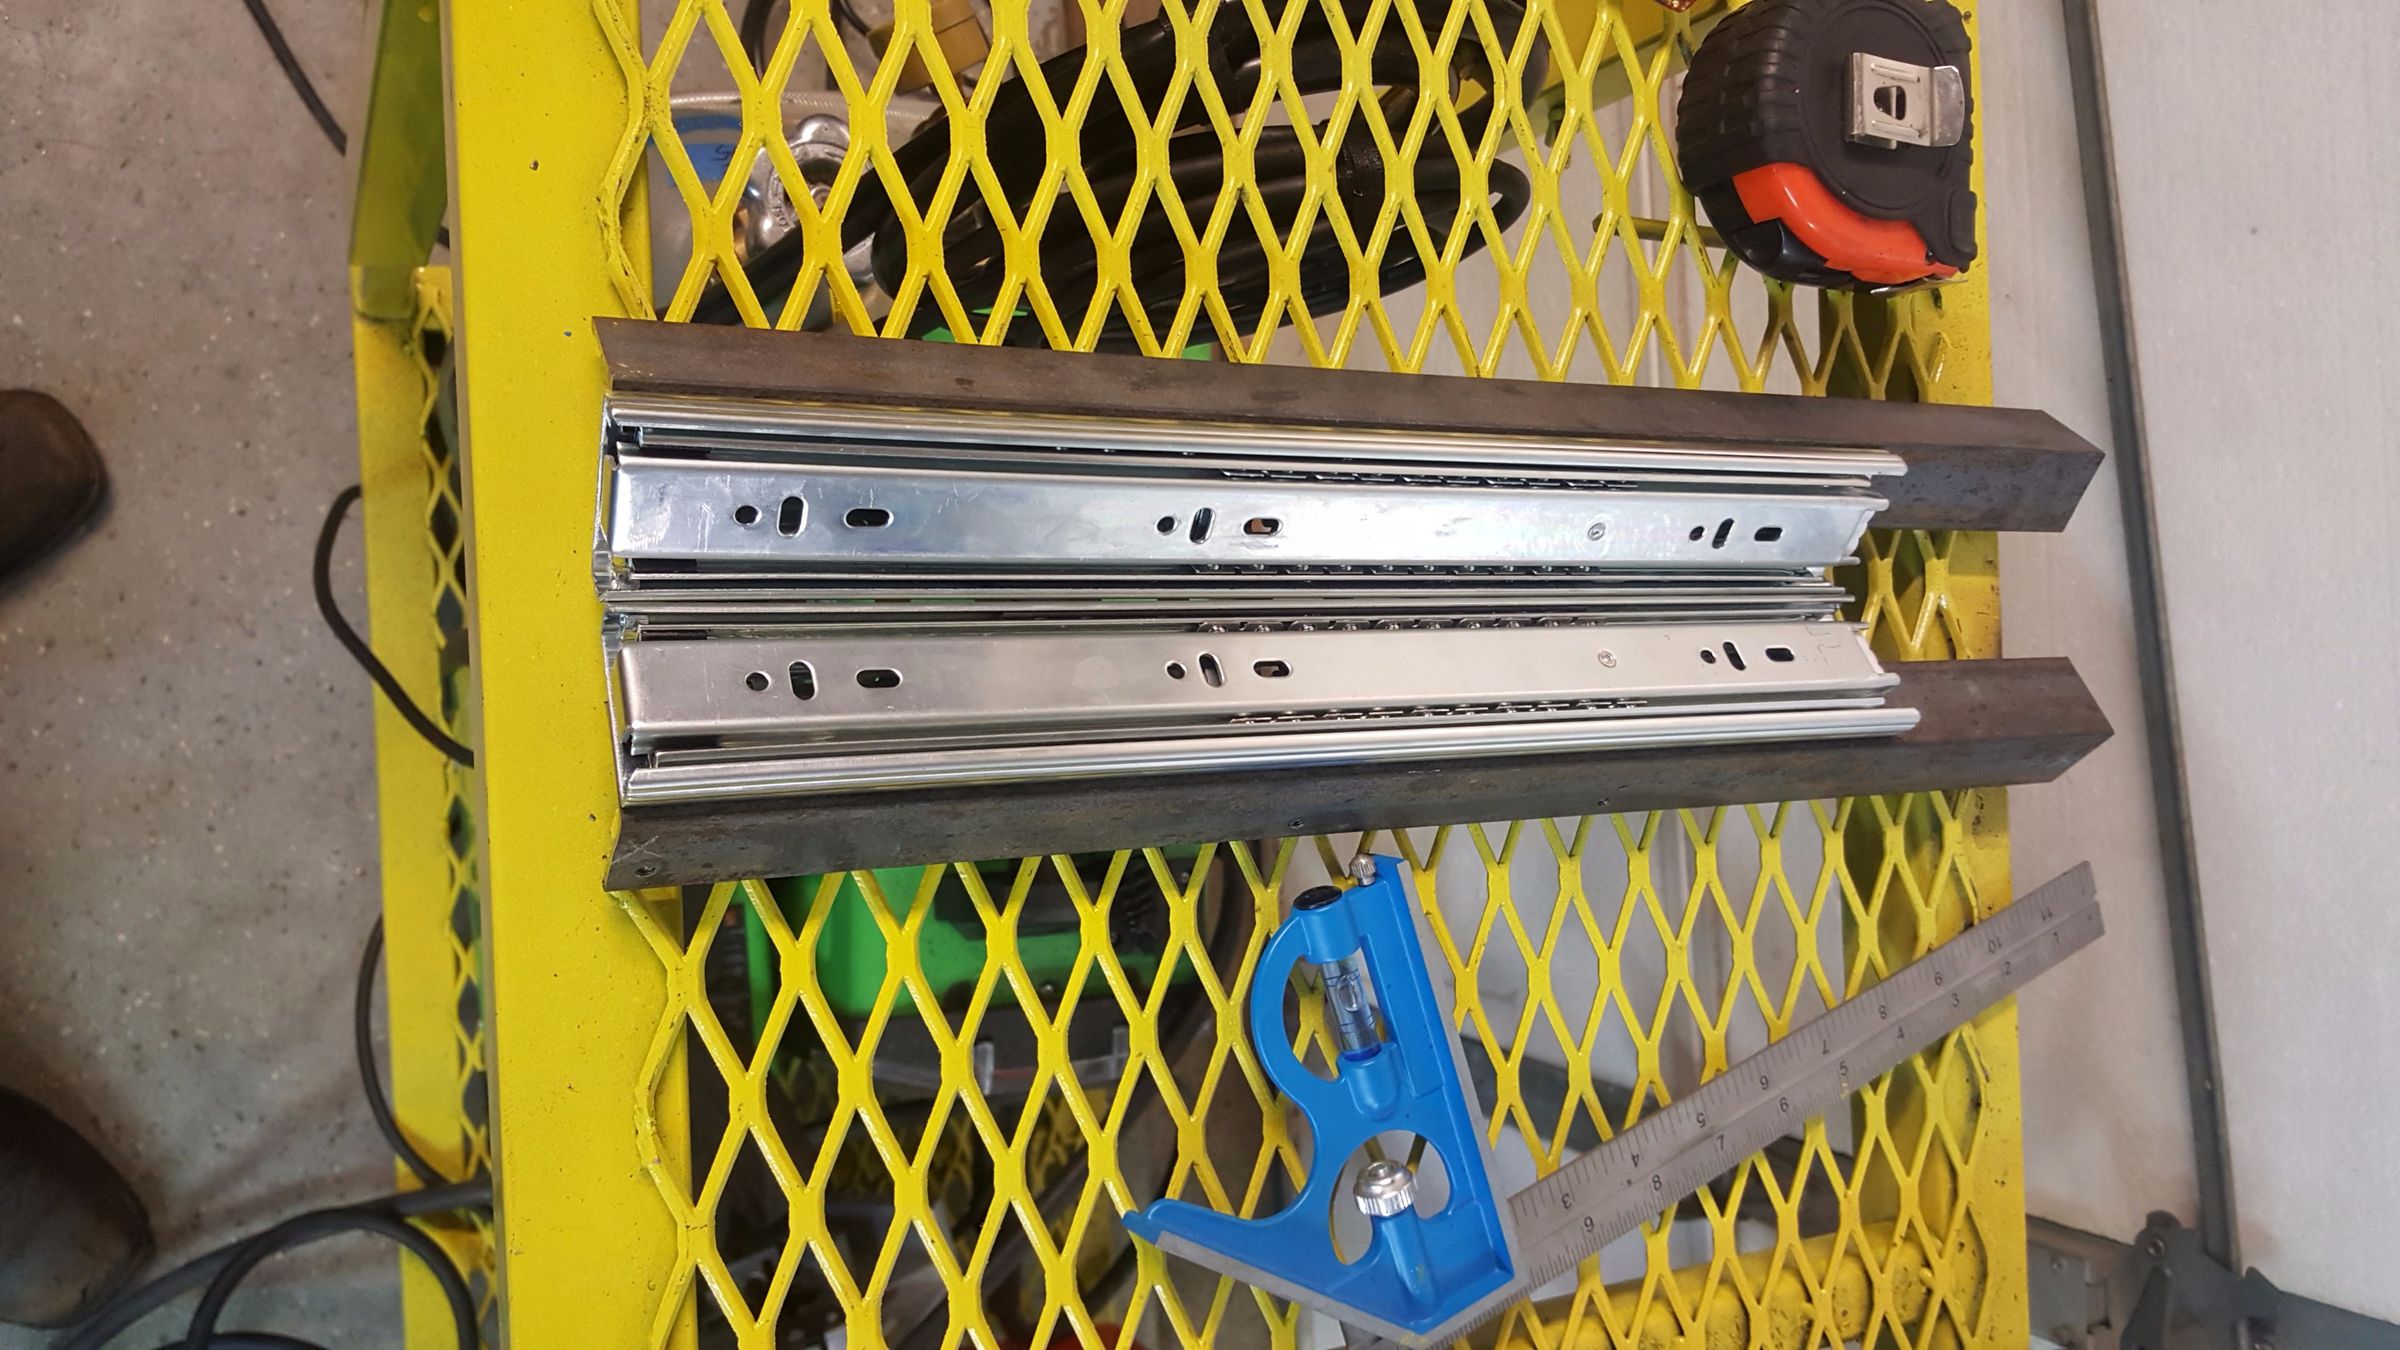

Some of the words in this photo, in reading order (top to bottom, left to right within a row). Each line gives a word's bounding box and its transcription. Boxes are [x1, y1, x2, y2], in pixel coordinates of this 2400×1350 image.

[1988, 936, 2003, 954] 10
[1934, 971, 1944, 987] 9
[1878, 1004, 1888, 1020] 8
[1821, 1038, 1831, 1055] 7
[1759, 1075, 1769, 1091] 6
[1583, 1215, 1594, 1233] 9
[1651, 1174, 1662, 1191] 8
[1716, 1133, 1725, 1151] 7
[1779, 1096, 1790, 1113] 6
[1839, 1060, 1848, 1077] 5
[1896, 1025, 1905, 1040] 4
[1951, 992, 1960, 1007] 3
[2002, 960, 2012, 976] 2
[1696, 1112, 1706, 1129] 5
[1630, 1152, 1640, 1169] 4
[1561, 1192, 1572, 1210] 3
